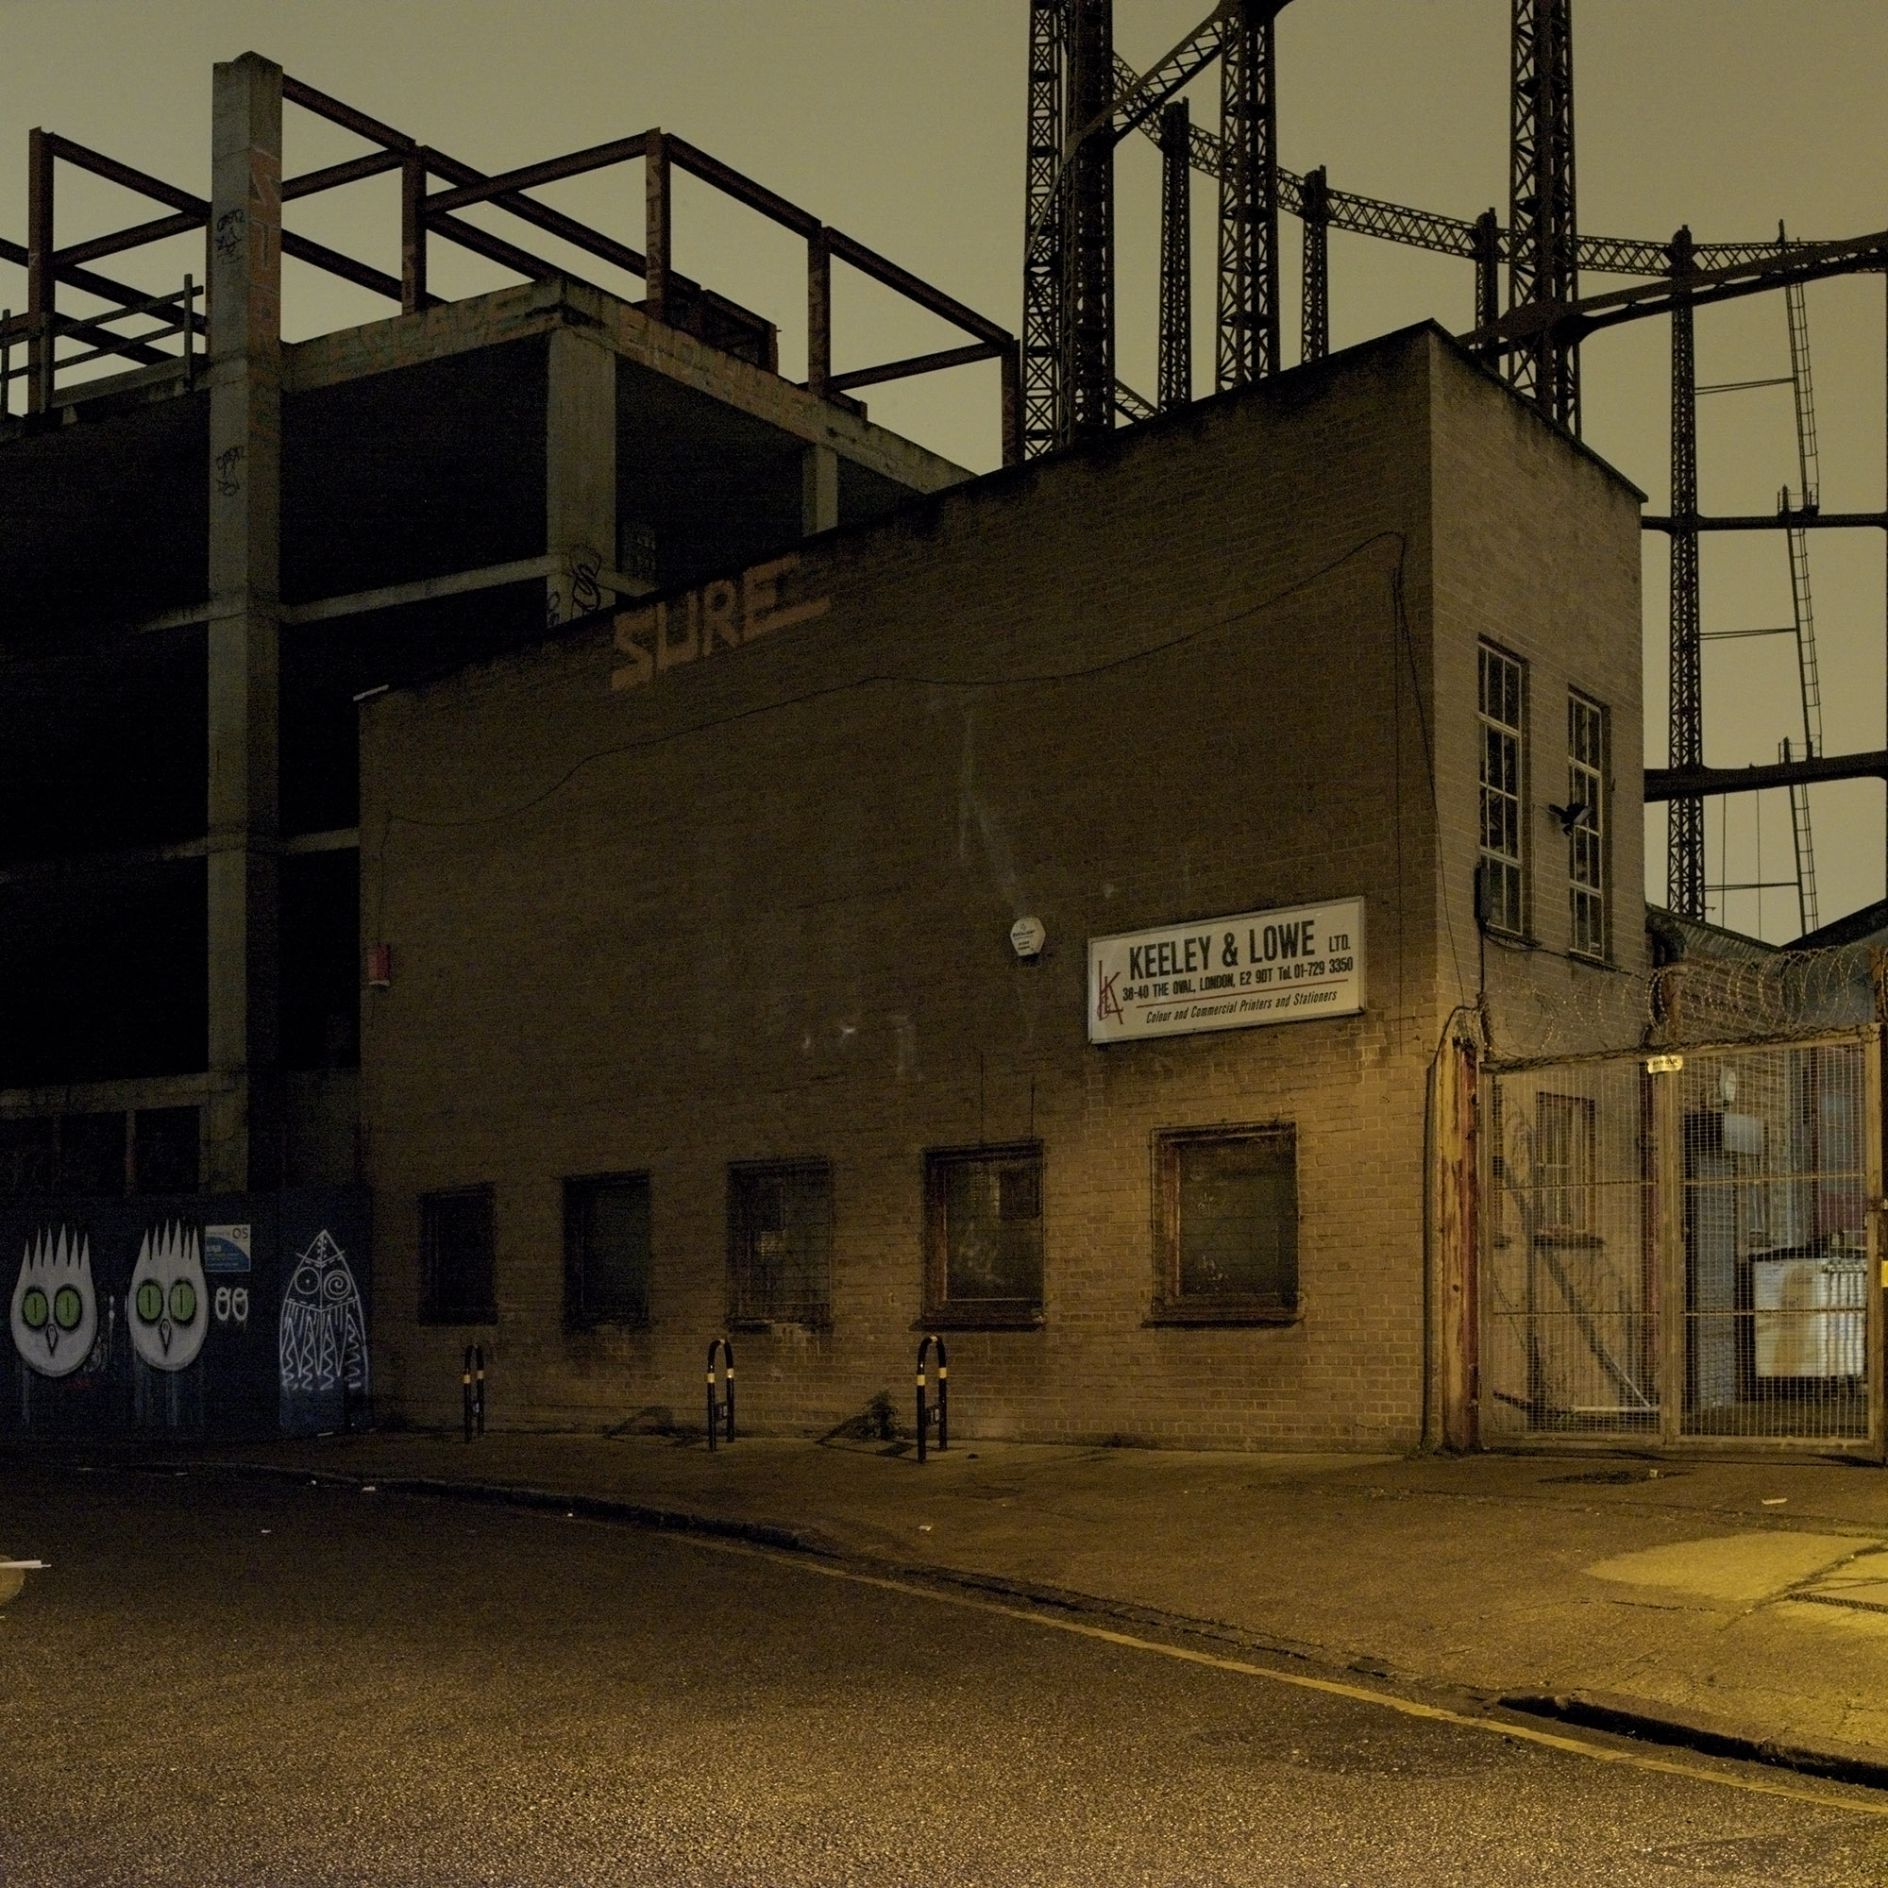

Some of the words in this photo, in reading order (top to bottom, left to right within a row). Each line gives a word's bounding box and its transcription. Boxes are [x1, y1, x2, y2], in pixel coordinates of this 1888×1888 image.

[611, 553, 832, 692] SURE
[1129, 935, 1211, 981] KEELEY
[1222, 932, 1239, 967] &
[1249, 920, 1315, 964] LOWE
[1152, 982, 1169, 998] THE
[1240, 971, 1252, 986] E2
[1294, 960, 1325, 979] 01-729
[1329, 957, 1353, 974] 3350
[1146, 1011, 1172, 1024] Colour
[1174, 1007, 1189, 1021] and
[1191, 1001, 1237, 1018] Commercial
[1240, 999, 1272, 1012] Printers
[1275, 994, 1291, 1008] and
[1294, 991, 1337, 1006] Stationers
